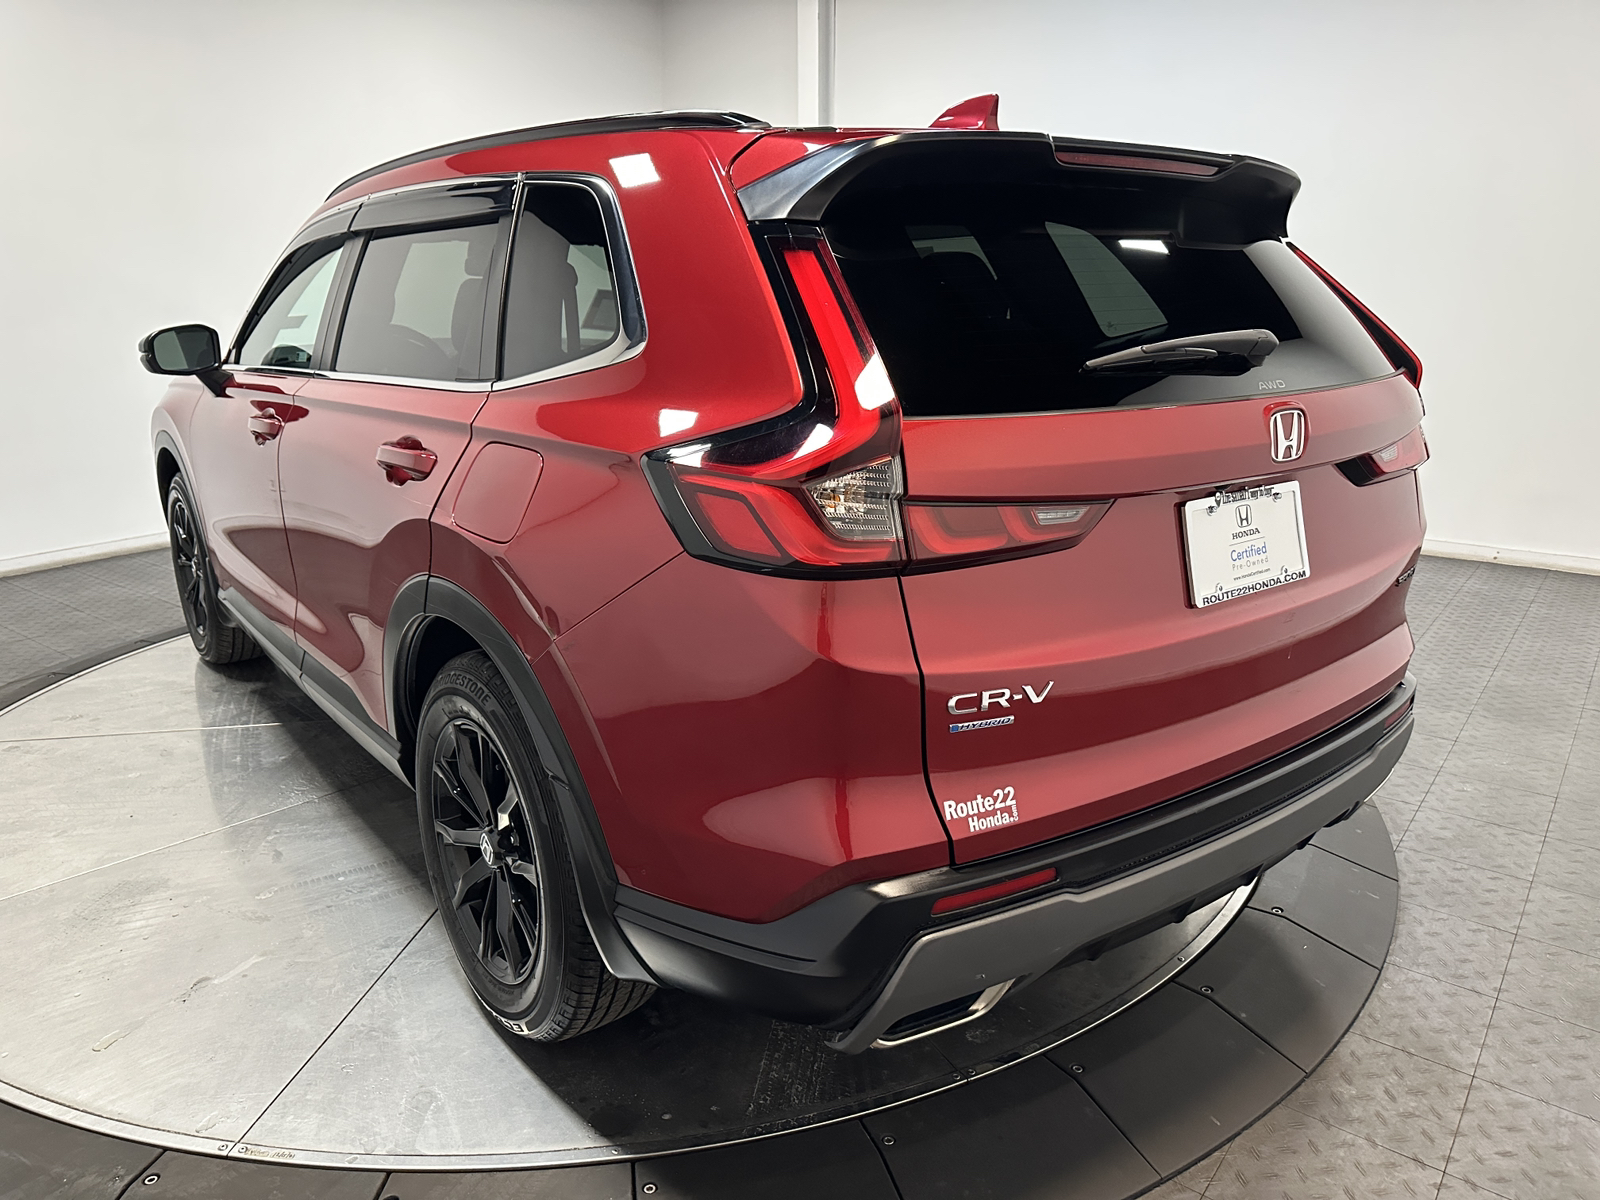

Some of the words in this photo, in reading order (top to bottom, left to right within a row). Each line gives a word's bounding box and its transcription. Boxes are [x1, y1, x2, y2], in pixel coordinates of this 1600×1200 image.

[1258, 379, 1286, 390] AWD
[1231, 527, 1261, 540] HONDA
[1230, 541, 1268, 562] Certified
[1231, 554, 1269, 571] Pre-Owned
[1202, 570, 1307, 606] ROUTE22HONDA.COM
[437, 671, 492, 707] RIDGESTONE
[947, 680, 1055, 715] CR-V
[959, 717, 1013, 732] HYBRID
[943, 786, 1017, 821] Route22
